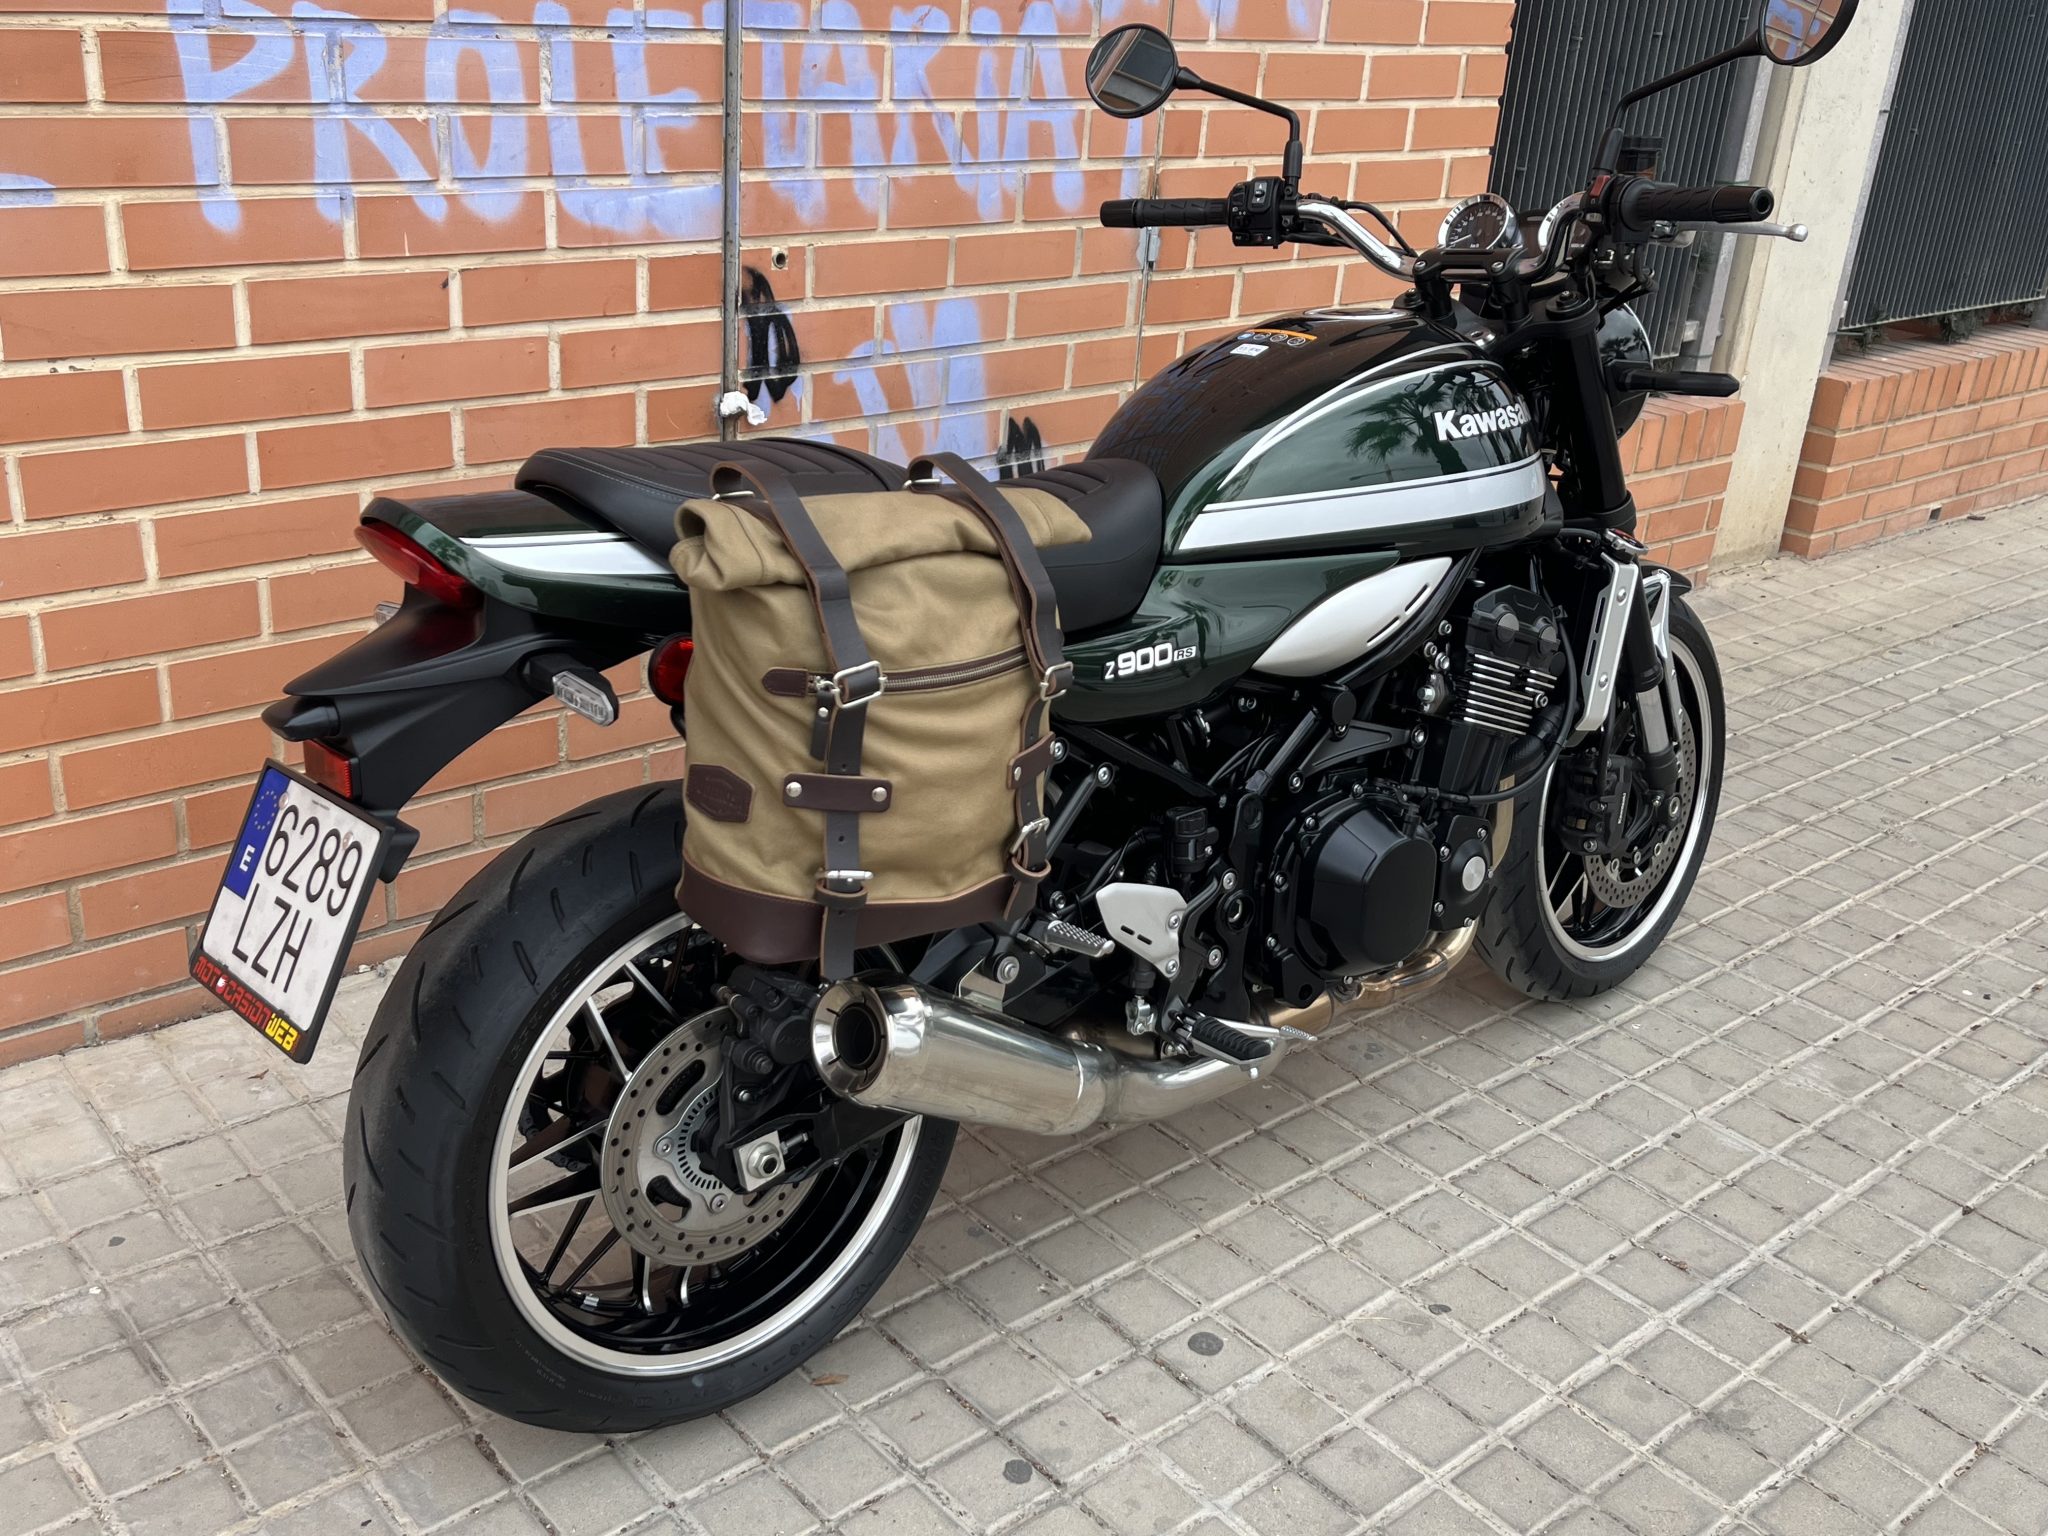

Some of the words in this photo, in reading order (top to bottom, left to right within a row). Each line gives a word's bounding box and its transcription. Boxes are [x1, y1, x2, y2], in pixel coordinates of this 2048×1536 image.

[1434, 394, 1531, 441] Kawasa
[240, 844, 256, 872] E
[265, 805, 362, 916] 6289
[232, 883, 312, 993] LZH
